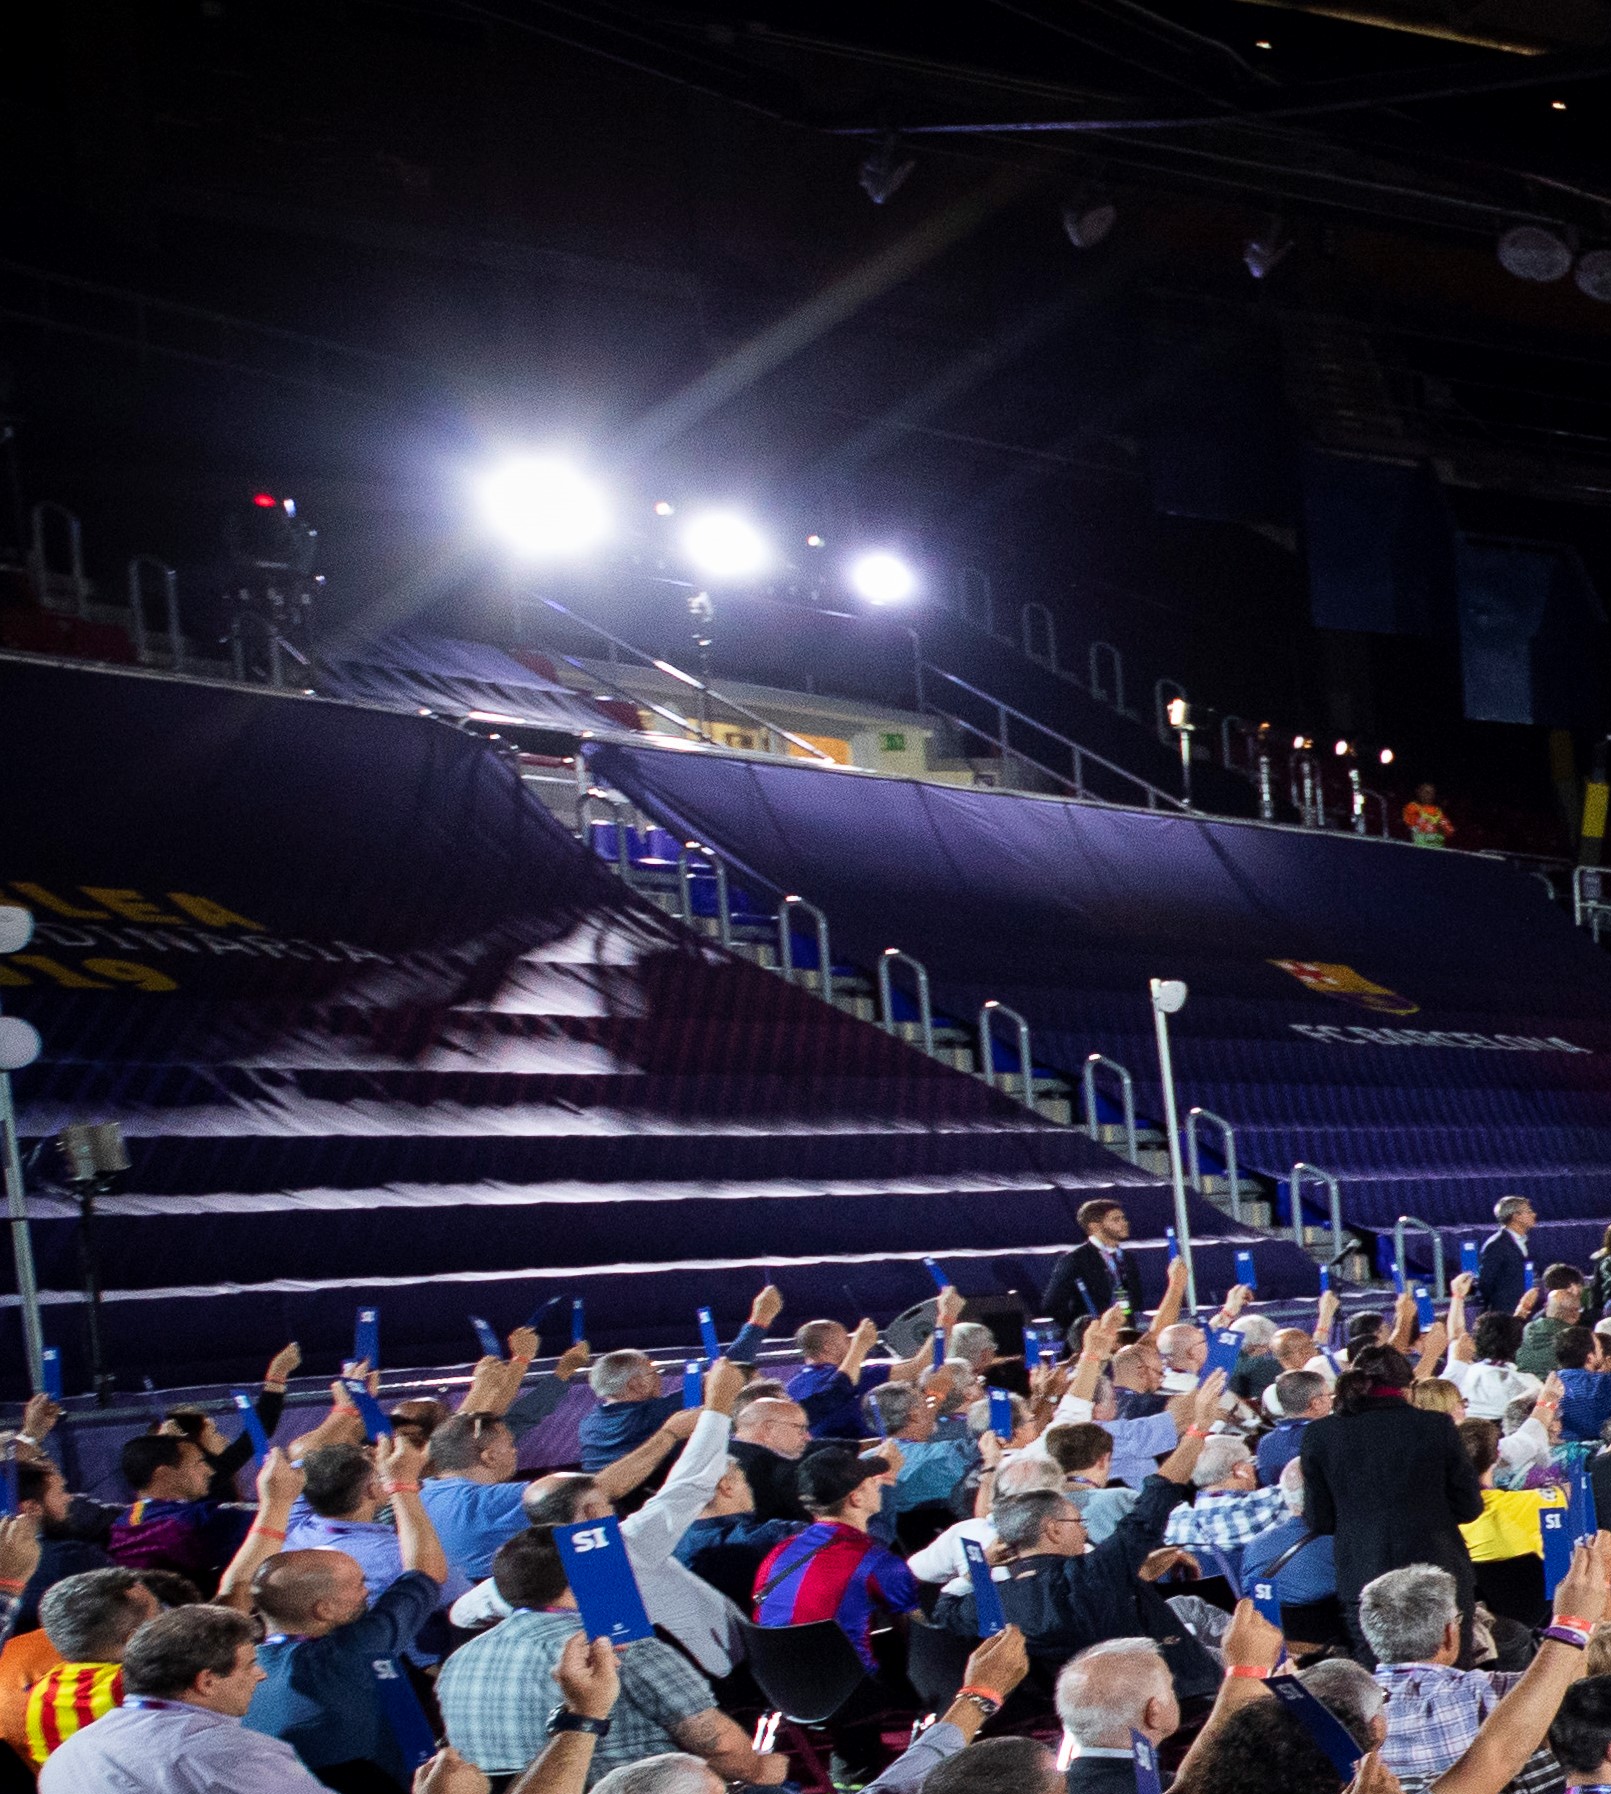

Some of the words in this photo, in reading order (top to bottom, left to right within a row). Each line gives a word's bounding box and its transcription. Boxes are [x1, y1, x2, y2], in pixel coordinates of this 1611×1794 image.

[1218, 1332, 1238, 1345] SI
[1545, 1513, 1561, 1529] SI
[572, 1527, 609, 1553] SI
[966, 1545, 983, 1562] SI
[1255, 1584, 1272, 1600] SI
[372, 1660, 398, 1679] SI
